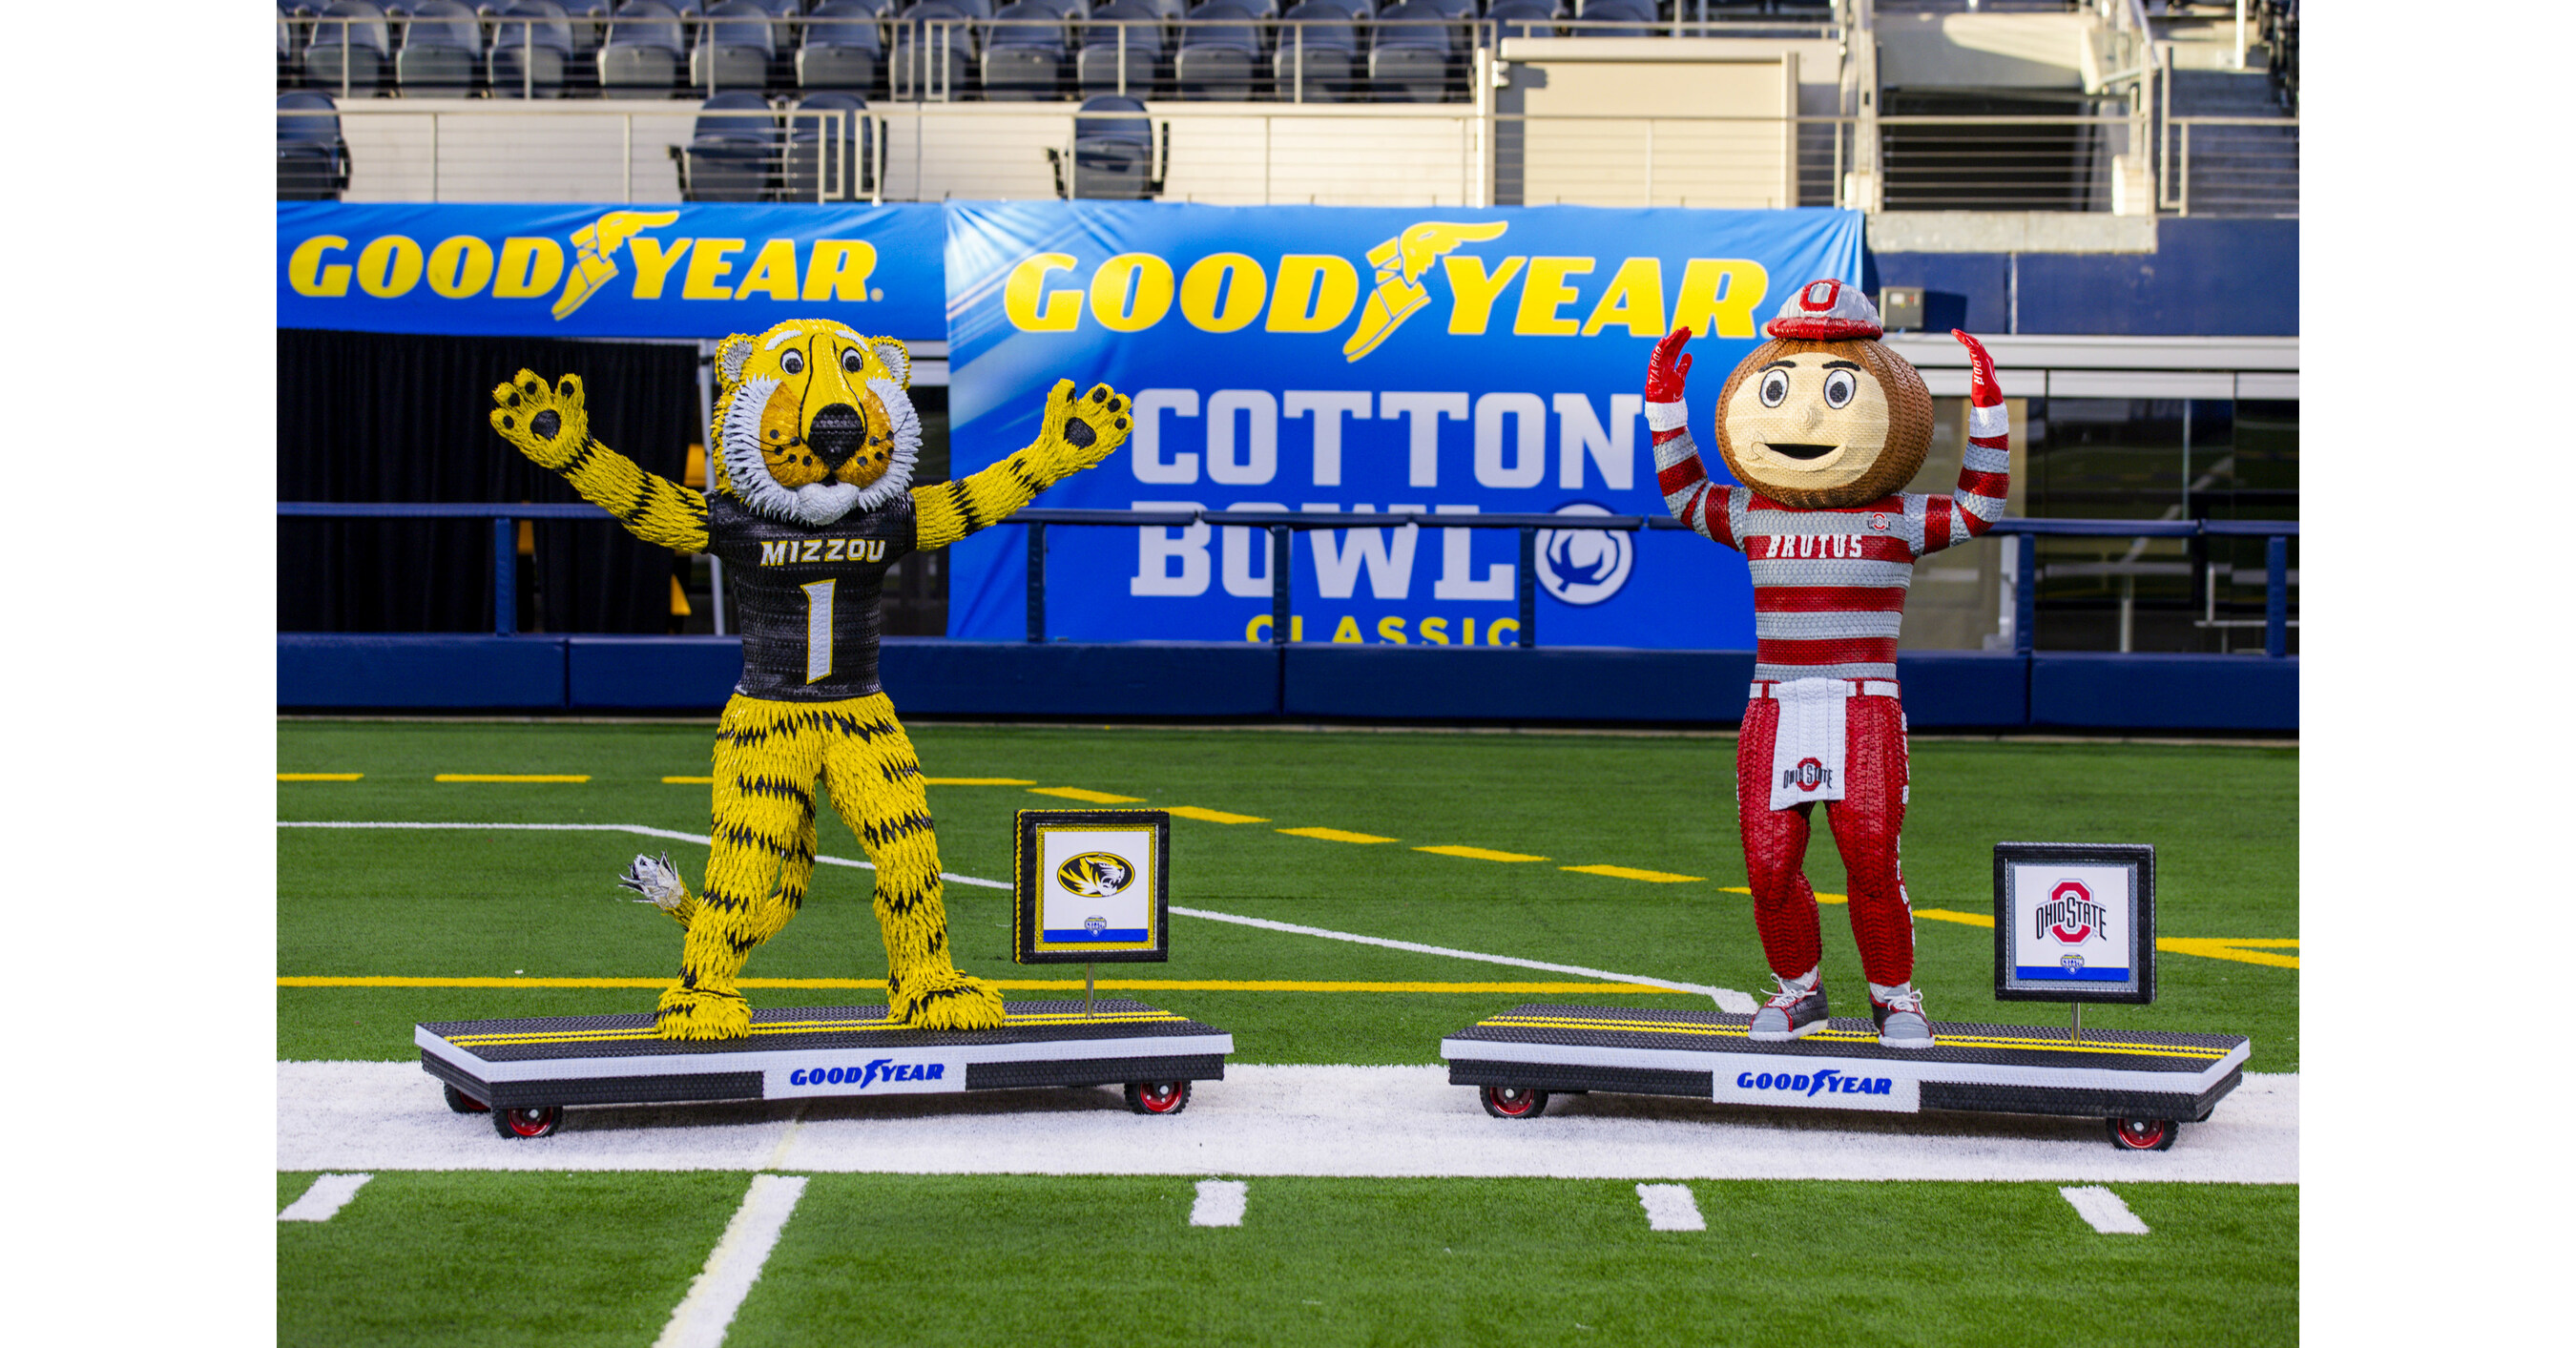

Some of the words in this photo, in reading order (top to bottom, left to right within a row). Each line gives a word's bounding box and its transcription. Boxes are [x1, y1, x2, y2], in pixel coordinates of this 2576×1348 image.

[288, 235, 879, 302] GOODYEAR
[1004, 252, 1769, 339] GOODYEAR
[1797, 279, 1841, 314] O
[1131, 387, 1642, 491] COTTON
[759, 538, 886, 567] MIZZOU
[1130, 501, 1516, 601] BOWL
[1765, 533, 1862, 559] BRUTUS
[800, 577, 837, 686] 1
[2035, 901, 2065, 941] OHIO
[2066, 896, 2107, 942] STATE
[790, 1061, 945, 1088] GOODYEAR
[1736, 1070, 1893, 1096] GOODYEAR
